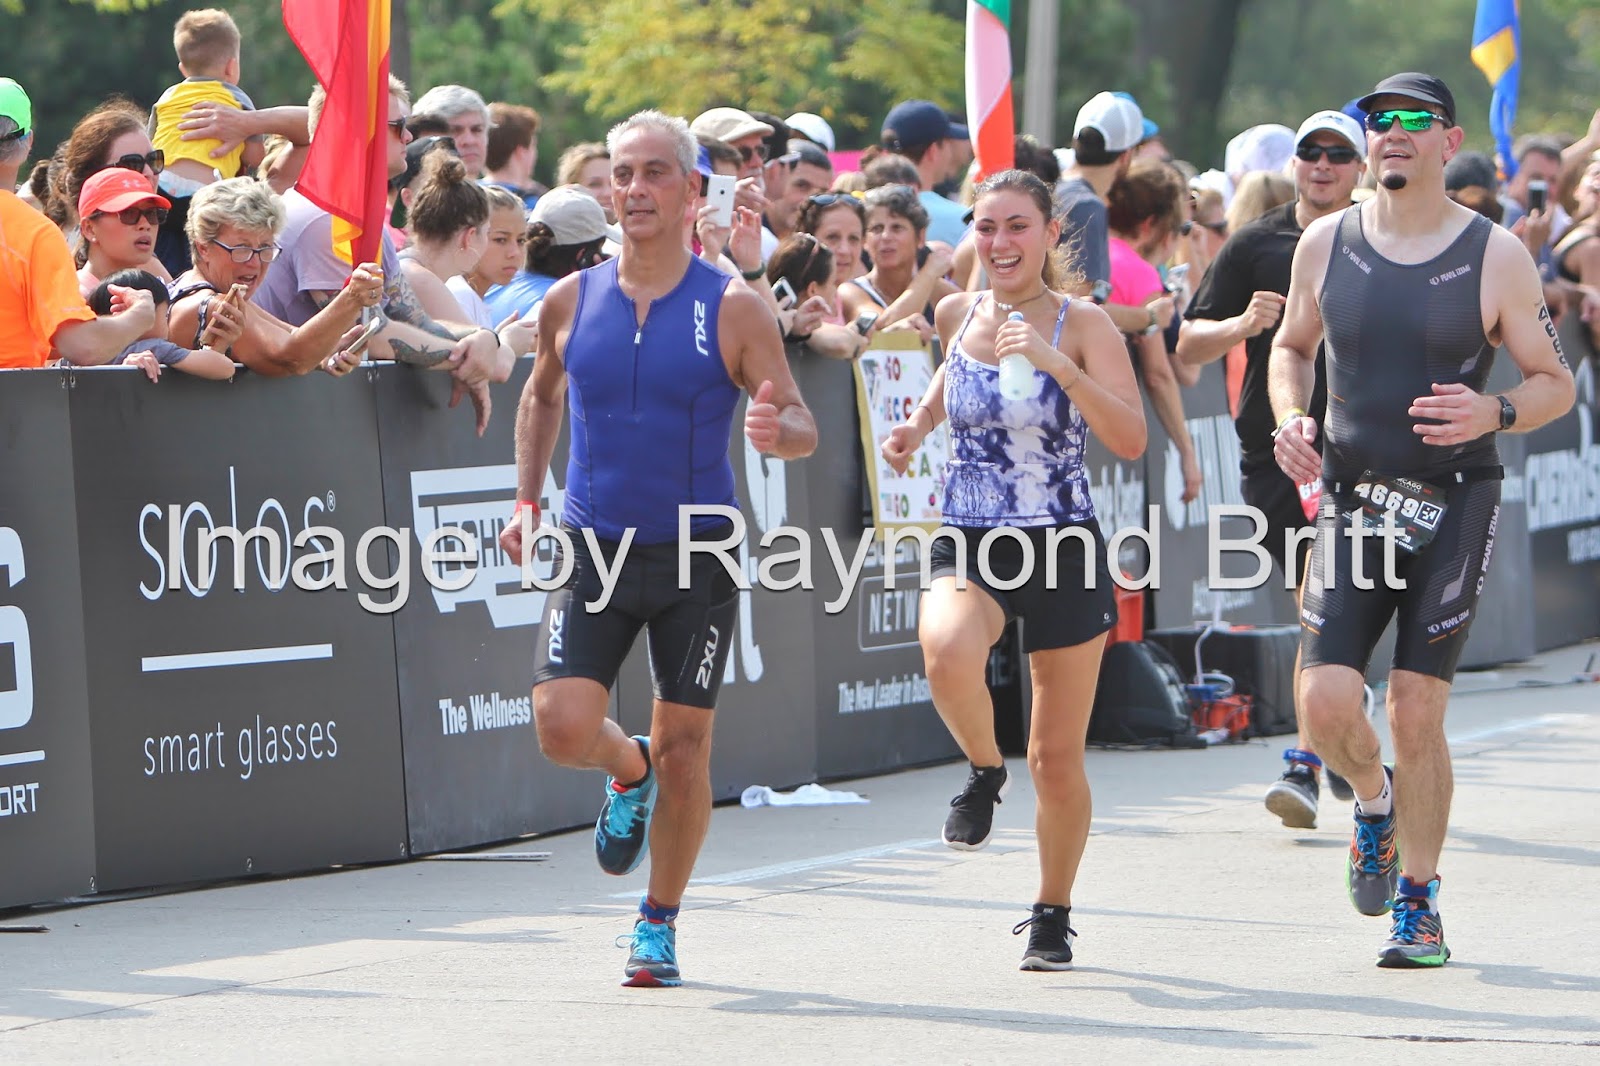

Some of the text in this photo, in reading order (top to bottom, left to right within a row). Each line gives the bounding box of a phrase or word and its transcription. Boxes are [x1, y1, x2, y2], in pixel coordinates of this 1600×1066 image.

[1440, 270, 1456, 282] PEARL
[694, 299, 709, 357] 2XU
[1354, 482, 1419, 518] 4669
[1481, 538, 1494, 572] PEARL
[549, 608, 564, 664] 2XU
[1441, 616, 1459, 630] PEARL
[695, 625, 719, 690] 2XU
[438, 691, 531, 735] The Wellness
[838, 681, 855, 714] The
[855, 680, 875, 711] New
[875, 678, 903, 709] Leader
[903, 673, 912, 705] in
[144, 713, 338, 780] smart glasses
